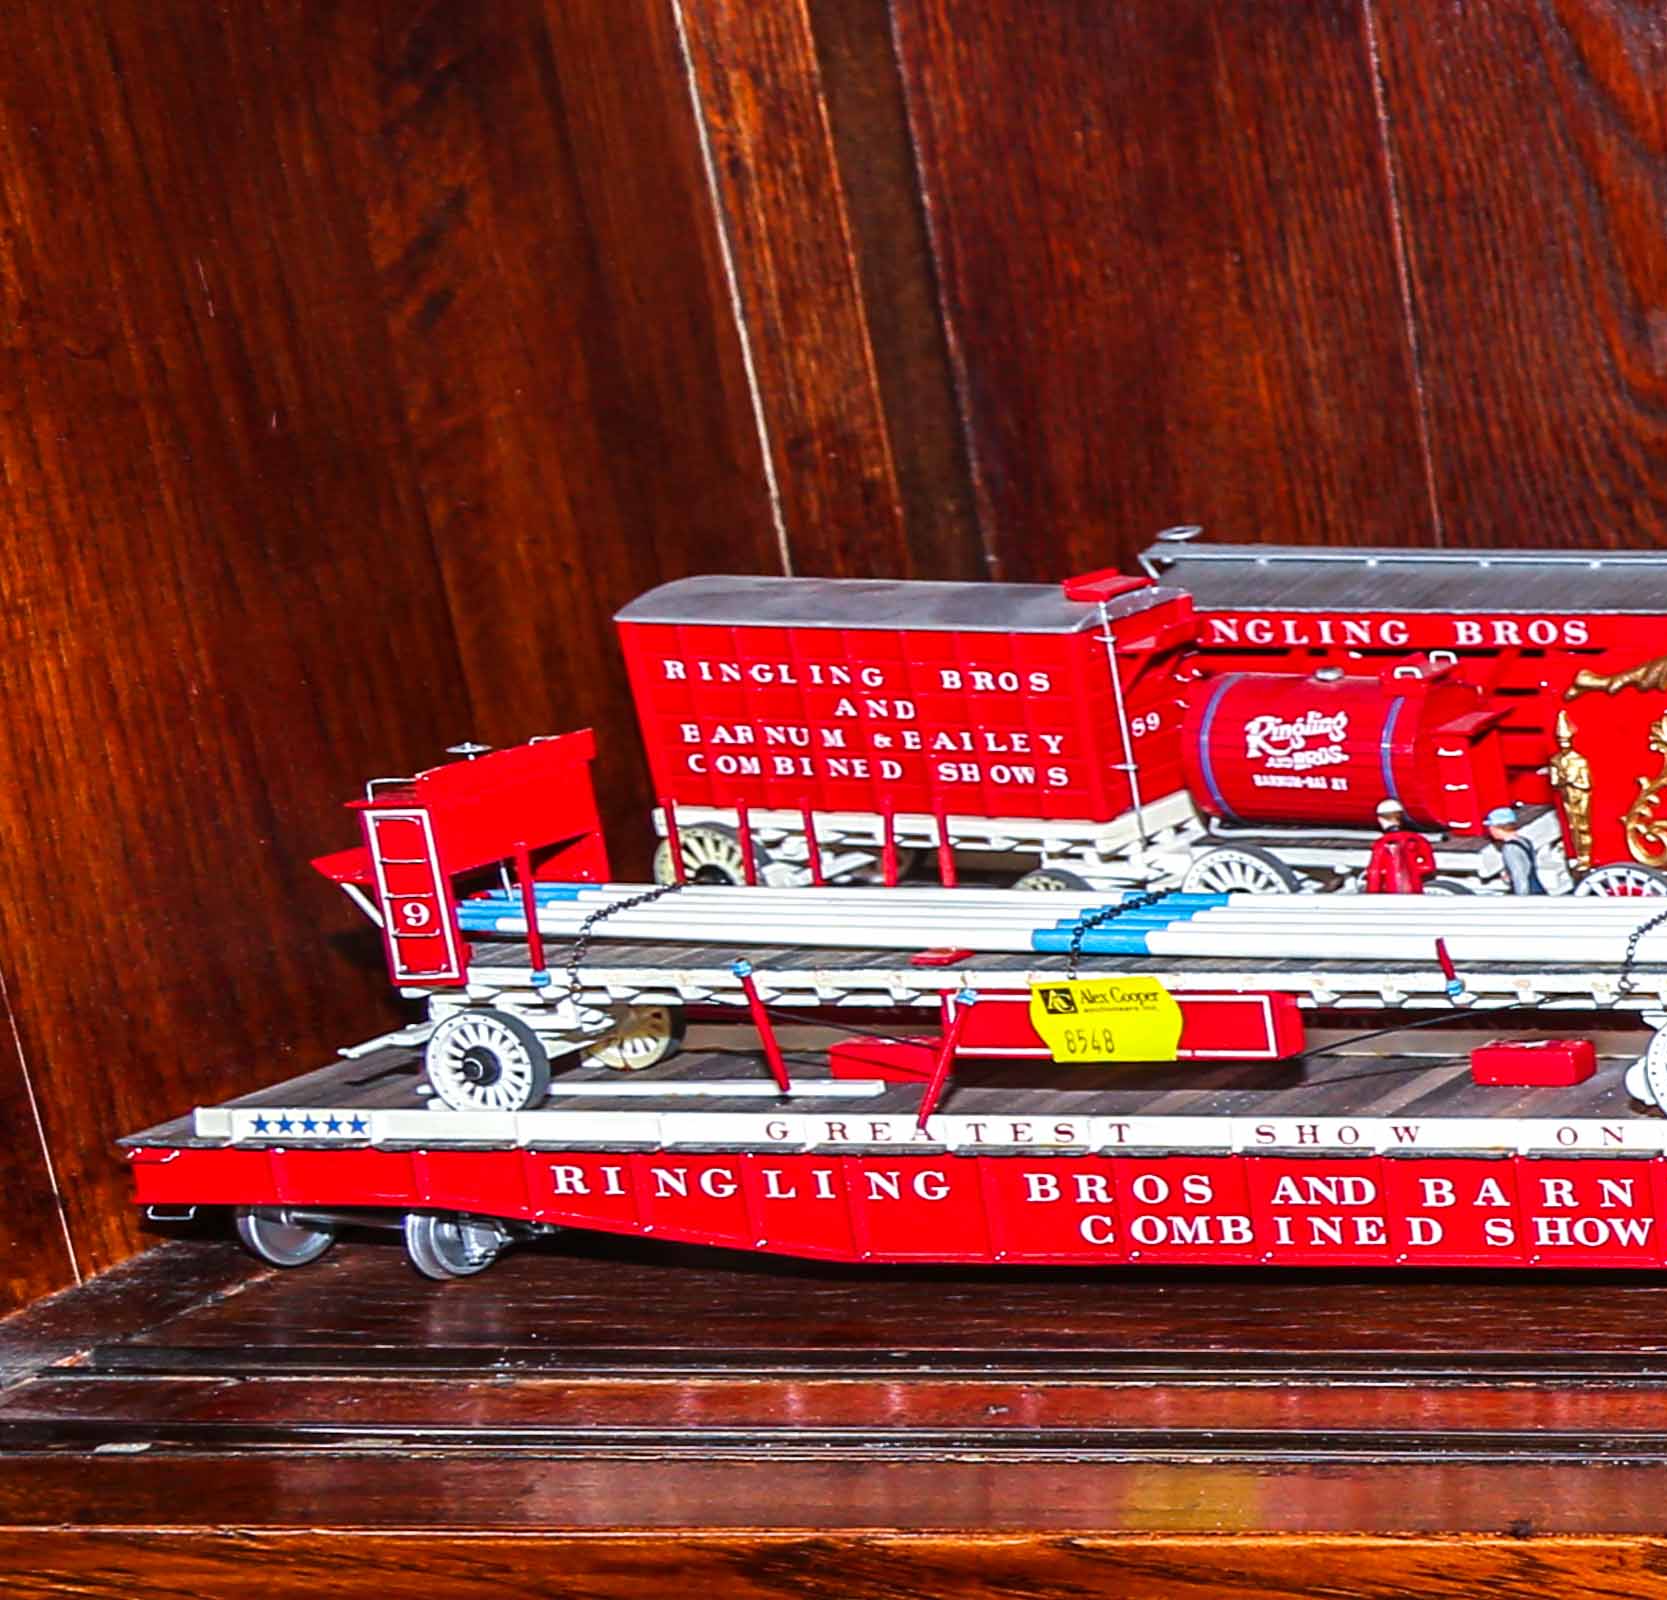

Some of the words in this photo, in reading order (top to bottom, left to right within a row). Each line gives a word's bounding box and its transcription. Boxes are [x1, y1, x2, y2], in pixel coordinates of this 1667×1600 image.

[1455, 620, 1589, 645] BROS
[664, 659, 884, 687] RINGLING
[941, 669, 1050, 692] BROS
[835, 698, 915, 719] AND
[1244, 711, 1348, 758] Ringling
[689, 755, 902, 778] COMBINED
[939, 762, 1068, 786] SHOWS
[402, 903, 430, 926] 9
[1080, 988, 1108, 1005] Alex
[1110, 986, 1160, 1006] Cooper
[1064, 1028, 1115, 1054] 8548
[766, 1120, 1130, 1143] GREATEST
[1256, 1125, 1421, 1146] SHOW
[1556, 1125, 1625, 1146] ON
[550, 1165, 950, 1201] RINGLING
[1024, 1173, 1213, 1204] BROS
[1272, 1177, 1375, 1206] AND
[1081, 1216, 1443, 1246] COMBINED
